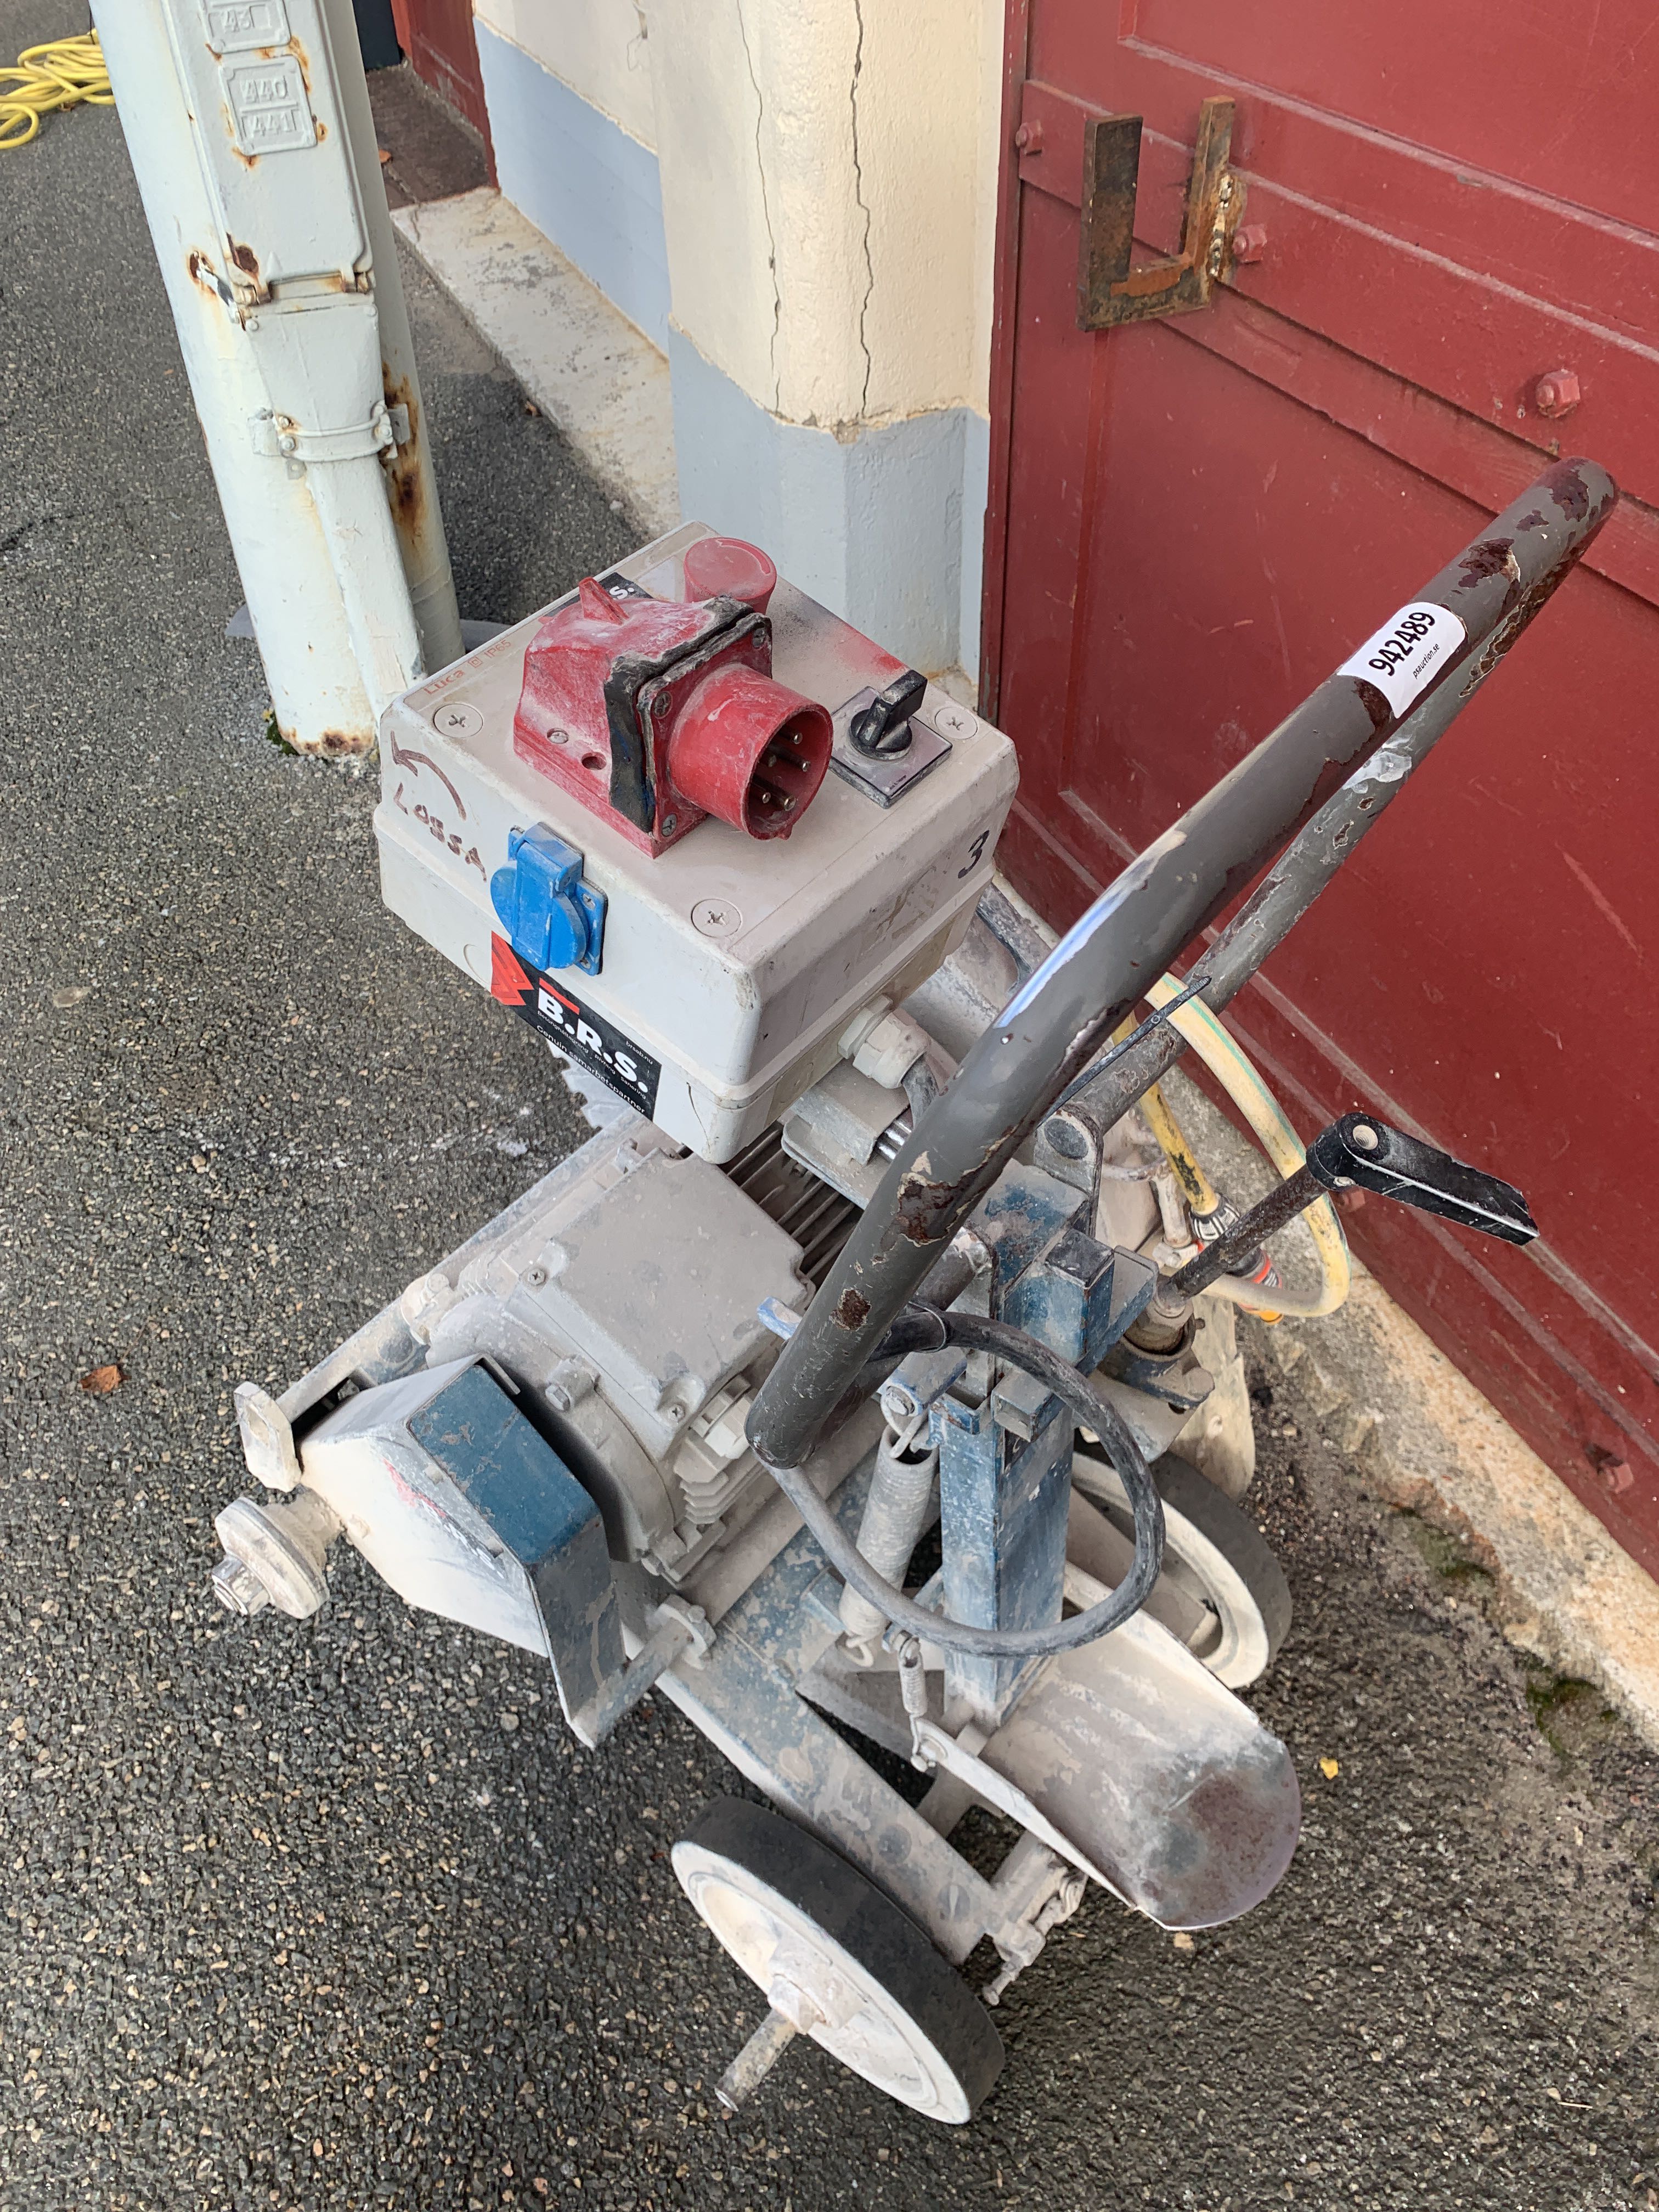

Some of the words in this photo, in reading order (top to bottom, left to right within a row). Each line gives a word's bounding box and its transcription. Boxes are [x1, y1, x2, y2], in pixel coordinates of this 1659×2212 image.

[240, 76, 288, 104] 440
[250, 112, 292, 137] 441
[484, 639, 511, 659] IP65
[1368, 612, 1436, 677] 942489
[1412, 643, 1441, 680] psauction.se
[957, 830, 990, 879] 3
[538, 987, 648, 1093] B.R.S.
[625, 1041, 653, 1065] brsab.nu
[537, 1025, 567, 1052] Genuin
[568, 1051, 646, 1114] samarbetspartner
[620, 1076, 646, 1100] Sanering
